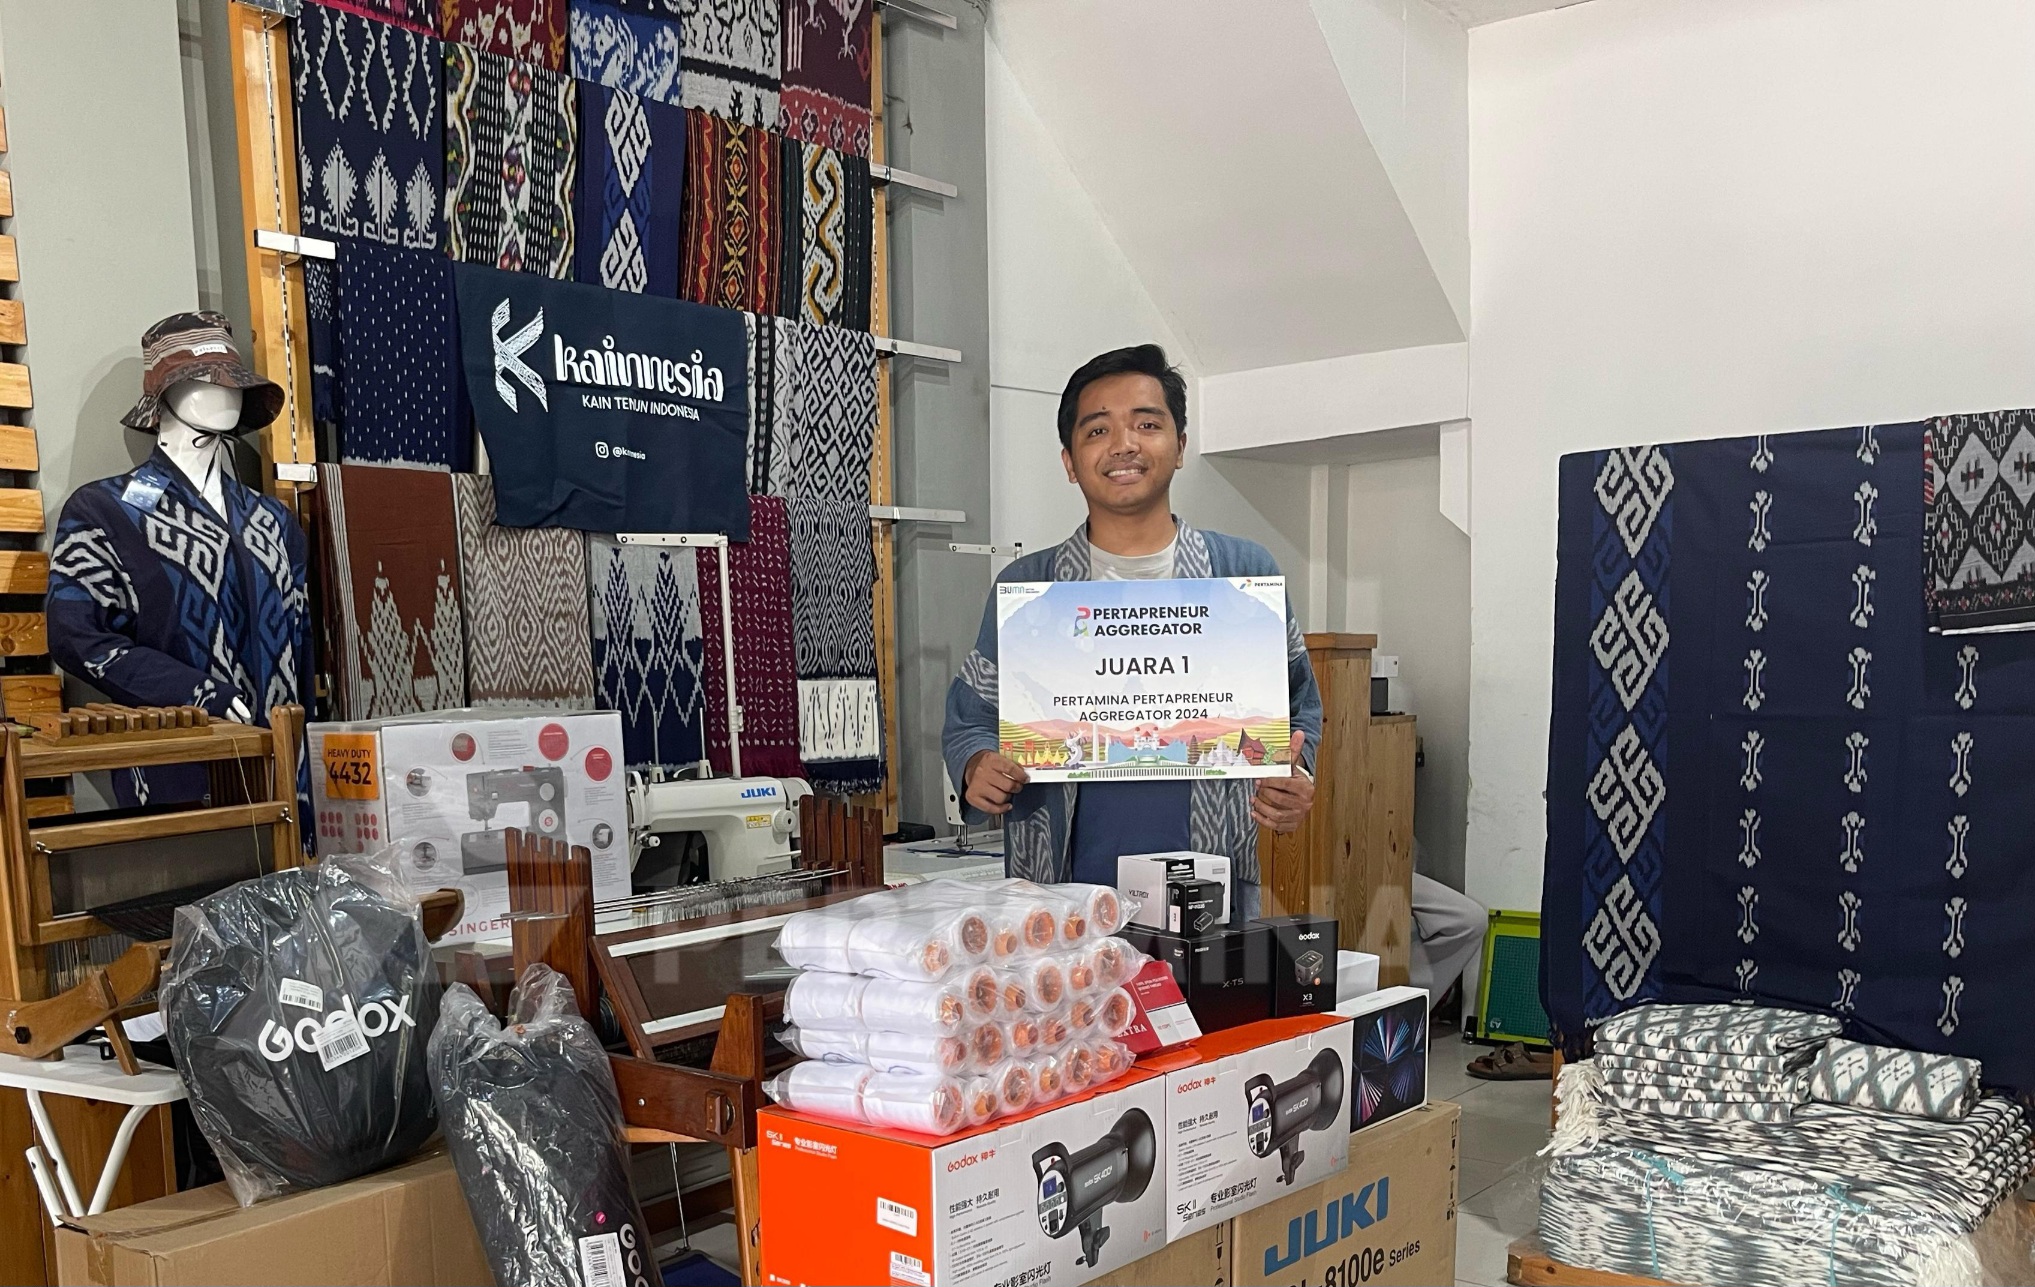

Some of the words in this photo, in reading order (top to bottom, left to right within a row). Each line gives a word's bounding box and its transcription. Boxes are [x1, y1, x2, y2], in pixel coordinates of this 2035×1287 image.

[581, 394, 612, 410] KAIN
[650, 401, 701, 422] INDONESIA
[1093, 605, 1210, 621] PERTAPRENEUR
[1093, 622, 1203, 637] AGGREGATOR
[1095, 656, 1175, 676] JUARA
[1181, 656, 1190, 674] 1
[1053, 694, 1130, 707] PERTAMINA
[1133, 692, 1234, 705] PERTAPRENEUR
[1079, 709, 1171, 723] AGGREGATOR
[1174, 708, 1209, 721] 2024
[327, 748, 350, 759] HEAVY
[351, 748, 372, 759] DUTY
[329, 761, 372, 785] 4432
[740, 786, 777, 799] JUKI
[1298, 931, 1320, 941] Godox
[1302, 993, 1313, 1001] X3
[1177, 1079, 1202, 1094] Godox
[947, 1154, 979, 1173] Godox
[1176, 1200, 1191, 1215] SK
[1263, 1176, 1390, 1277] JUKI
[1389, 1240, 1421, 1267] Series
